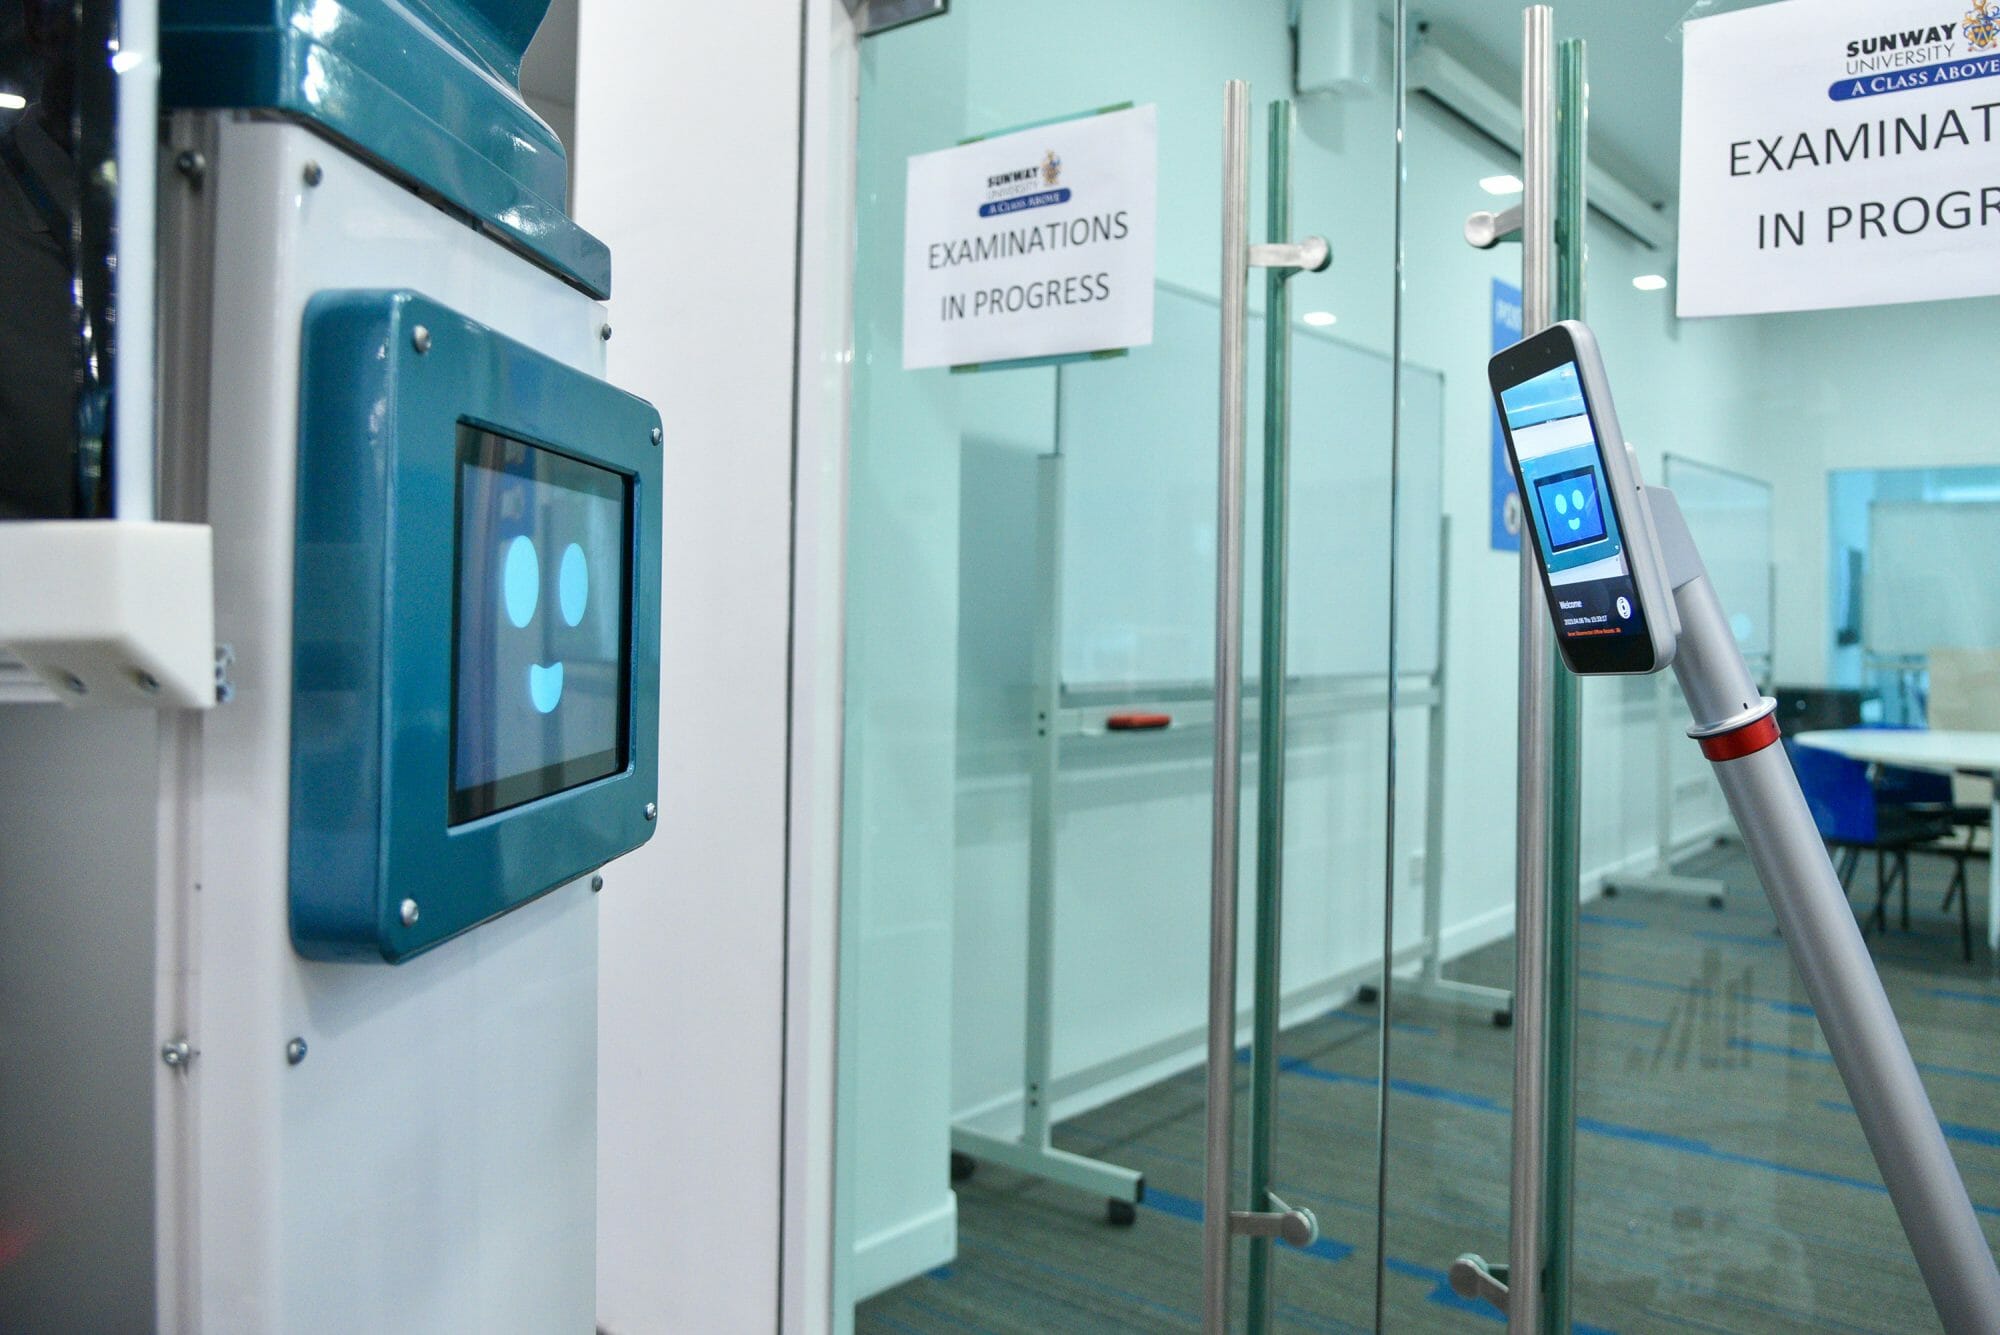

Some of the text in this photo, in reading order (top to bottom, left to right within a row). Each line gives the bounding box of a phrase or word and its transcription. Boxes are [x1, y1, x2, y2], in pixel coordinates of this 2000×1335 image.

[1846, 22, 1957, 58] SUNWAY
[1846, 43, 1956, 76] UNIVERSITY
[1851, 59, 2000, 97] A CLASS ABOVE
[1729, 101, 2000, 177] EXAMINAT
[987, 166, 1039, 188] SUNWAY
[1758, 186, 2000, 250] IN PROGR
[928, 211, 1129, 270] EXAMINATIONS
[941, 272, 1110, 321] IN PROGRESS
[1559, 600, 1582, 610] Welcome
